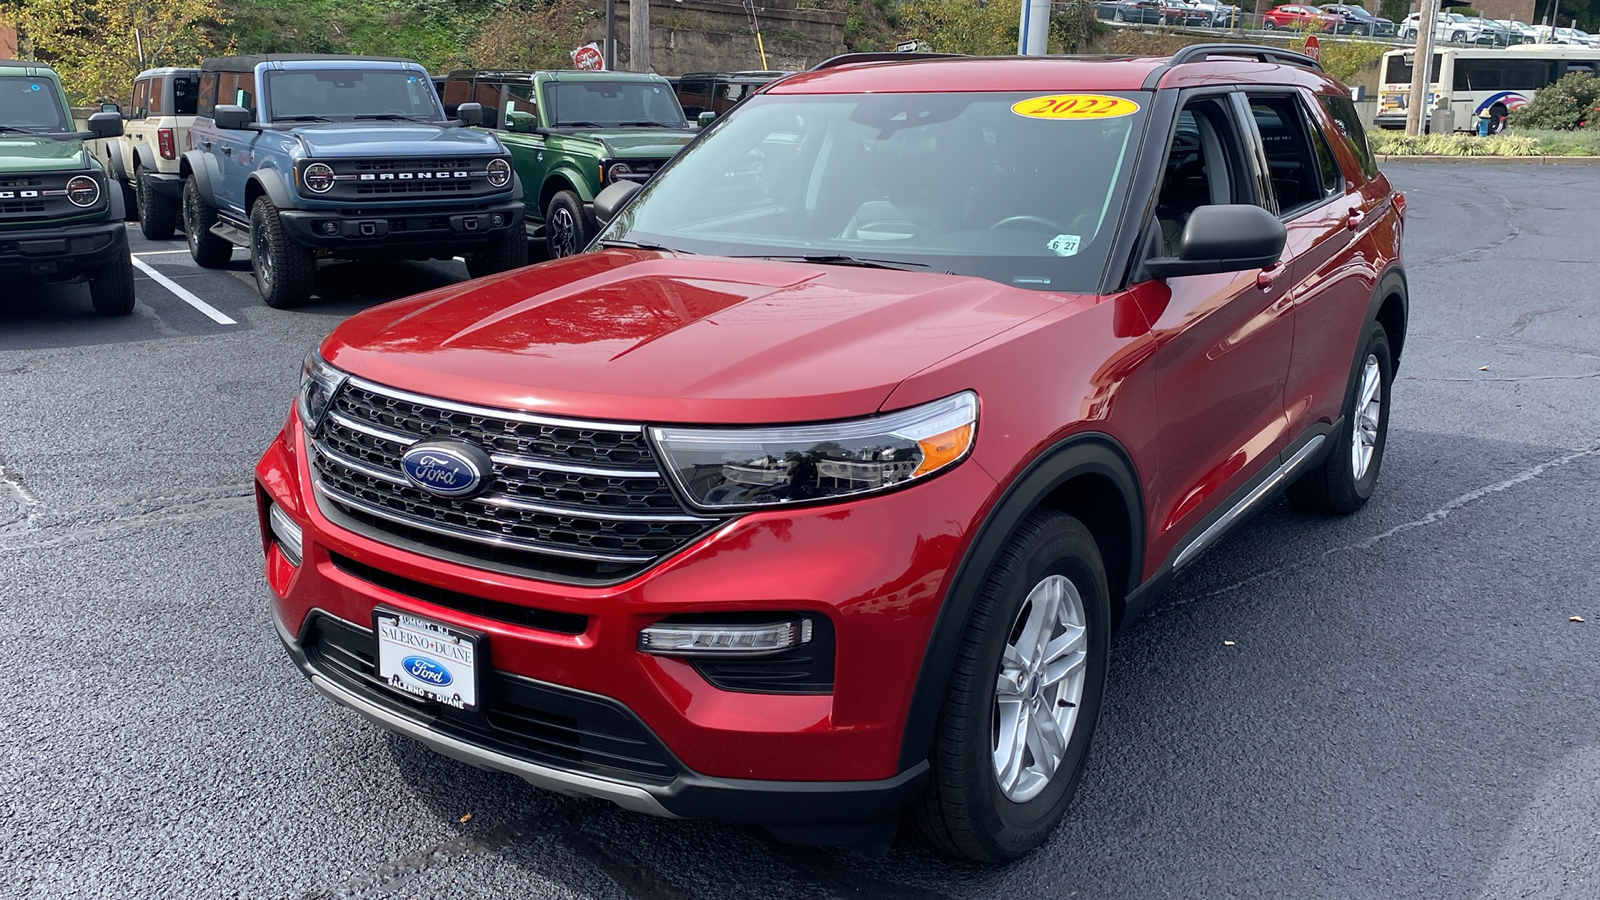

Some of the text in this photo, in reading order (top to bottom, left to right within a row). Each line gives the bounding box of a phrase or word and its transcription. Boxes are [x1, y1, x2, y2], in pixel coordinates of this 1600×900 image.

[1029, 98, 1119, 114] 2022
[360, 171, 468, 180] BRONCO
[1052, 240, 1077, 251] 6 27
[415, 455, 459, 485] Ford
[382, 627, 472, 664] SALERNO DUANE
[412, 660, 443, 683] Ford
[388, 678, 464, 709] SALERNO DUANE
